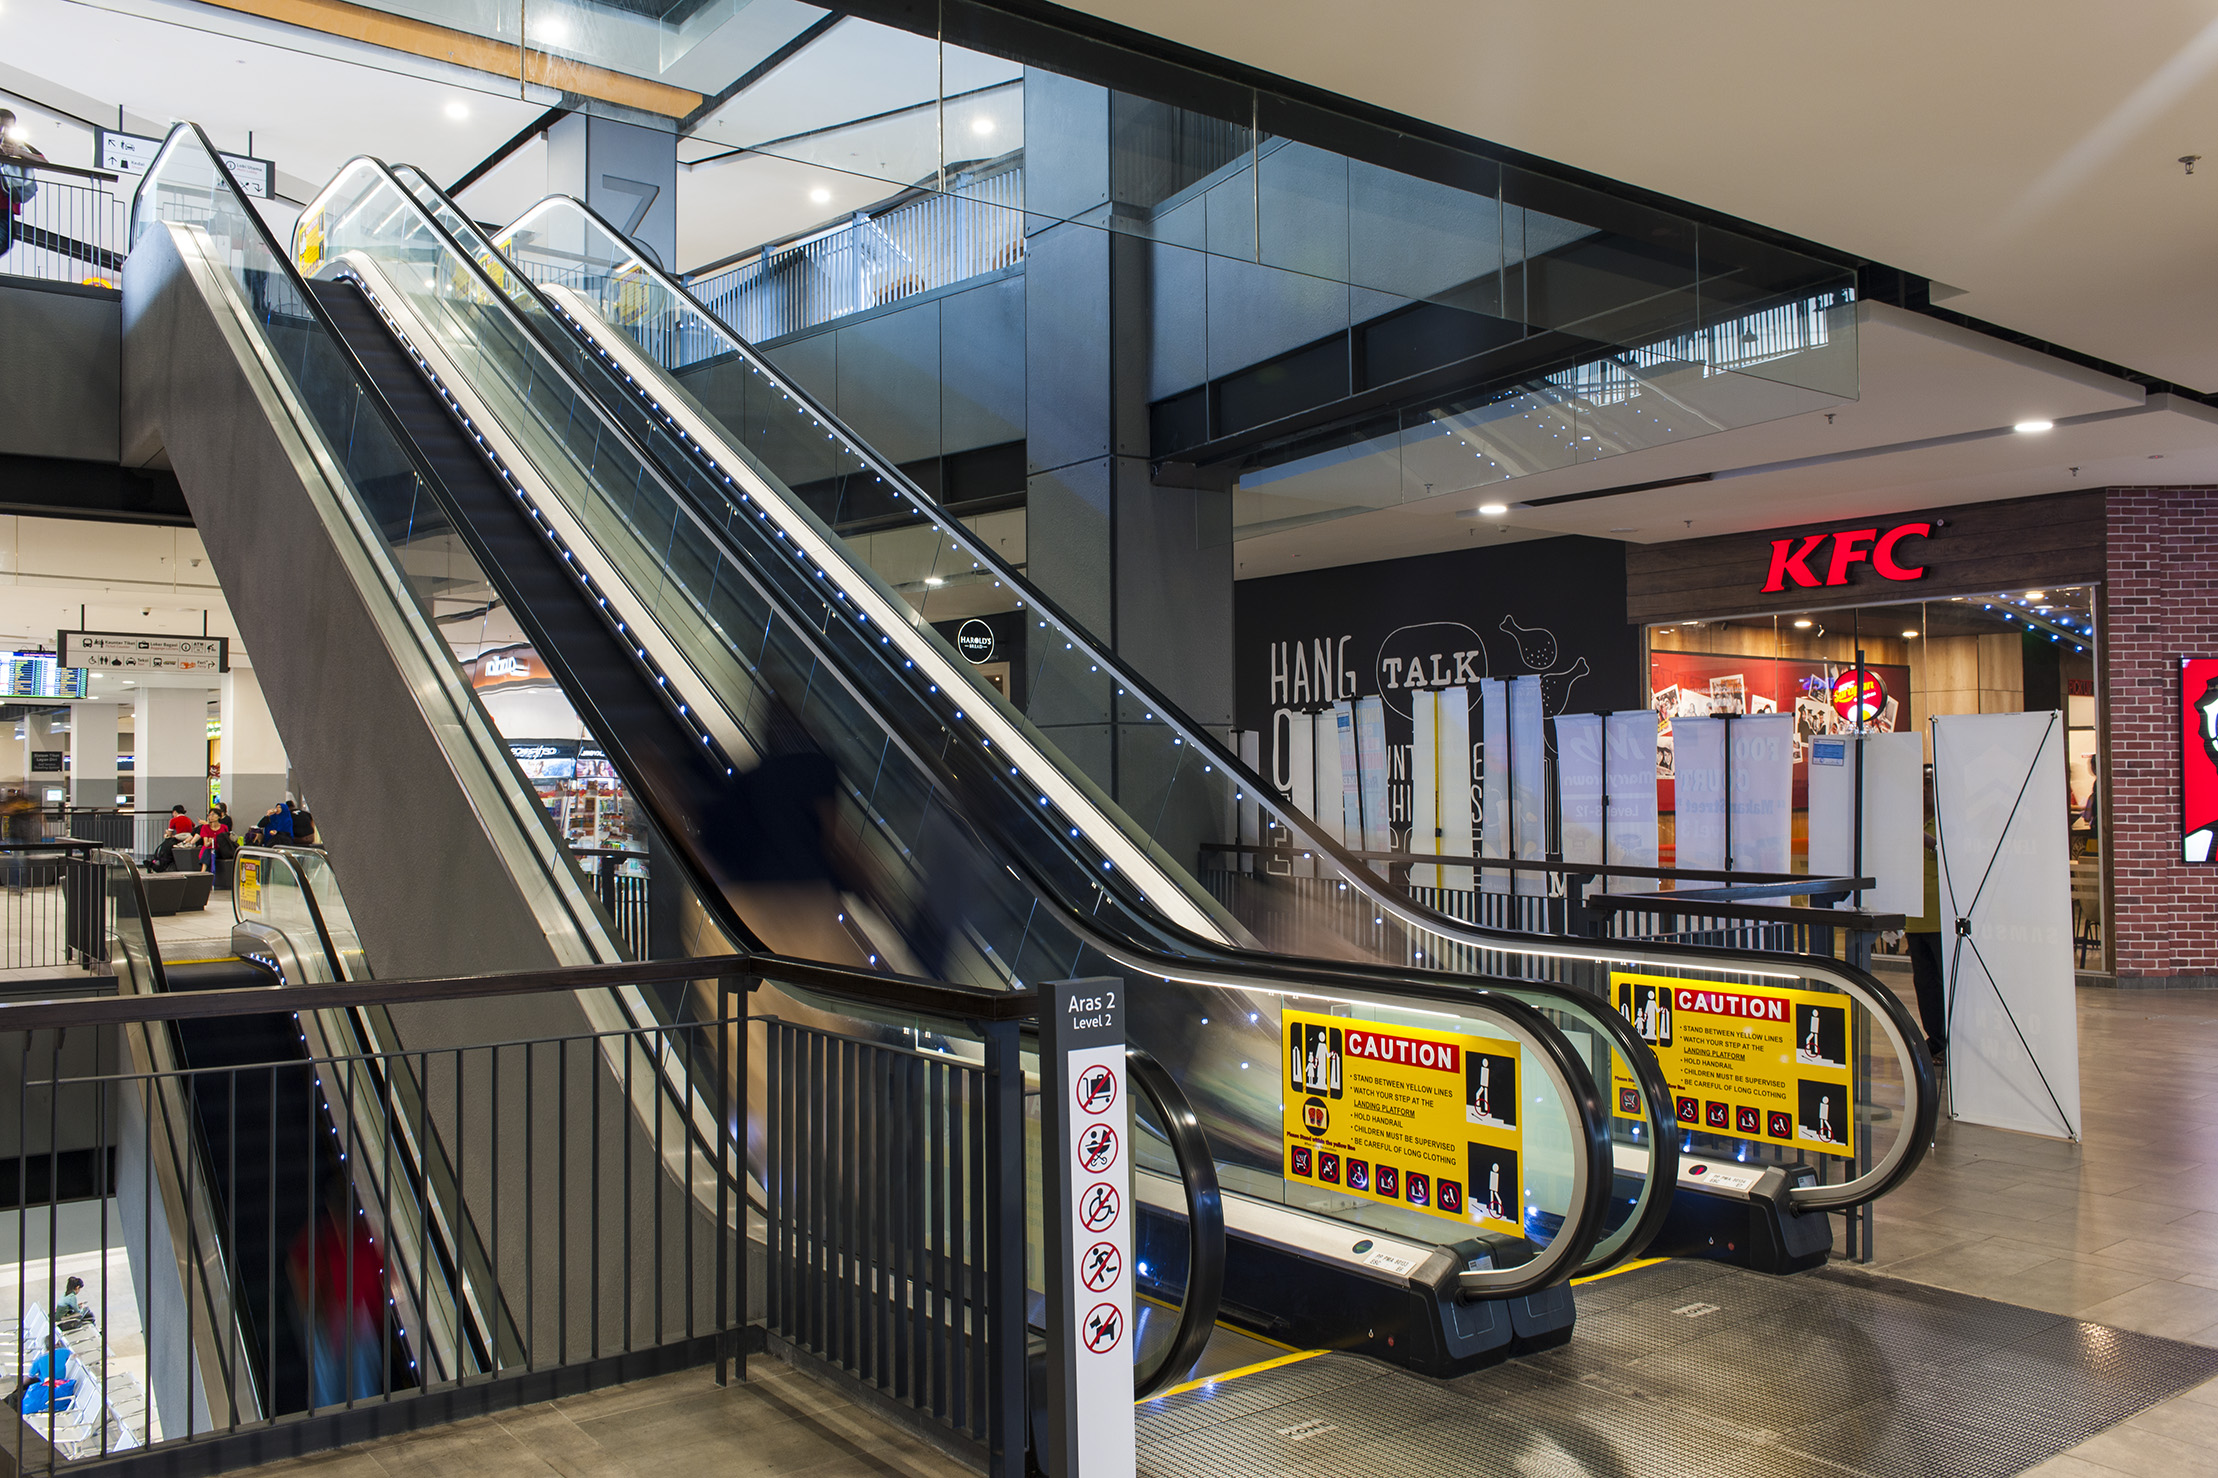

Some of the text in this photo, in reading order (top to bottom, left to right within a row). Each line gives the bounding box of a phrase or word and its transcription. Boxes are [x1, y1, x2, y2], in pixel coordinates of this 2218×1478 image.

[1760, 522, 1931, 593] KFC
[1271, 635, 1357, 705] HANG
[1382, 650, 1481, 689] TALK
[1068, 991, 1116, 1013] Aras 2
[1678, 991, 1782, 1020] CAUTION
[1073, 1013, 1112, 1030] Level 2
[1683, 1025, 1784, 1044] STAND BETWEEN YELLOW LINES
[1683, 1036, 1705, 1044] WATCH
[1706, 1038, 1724, 1047] YOUR
[1724, 1041, 1741, 1049] STEP
[1348, 1033, 1452, 1070] CAUTION
[1683, 1047, 1746, 1061] LANDING PLATFORM
[1683, 1057, 1734, 1070] HOLD HANDRAIL
[1353, 1073, 1453, 1098] STAND BETWEEN YELLOW LINES
[1684, 1068, 1786, 1089] CHILDREN MUST BE SUPERVISED
[1353, 1086, 1375, 1097] WATCH
[1376, 1091, 1393, 1101] YOUR
[1394, 1094, 1411, 1103] STEP
[1421, 1099, 1434, 1108] THE
[1694, 1080, 1722, 1091] CAREFUL
[1723, 1084, 1732, 1092] OF
[1734, 1086, 1752, 1095] LONG
[1753, 1088, 1787, 1100] CLOTHING
[1354, 1099, 1416, 1117] LANDING PLATFORM
[1354, 1112, 1404, 1129] HOLD HANDRAIL
[1354, 1124, 1456, 1152] CHILDREN MUST BE SUPERVISED
[1354, 1137, 1457, 1166] BE CAREFUL OF LONG CLOTHING
